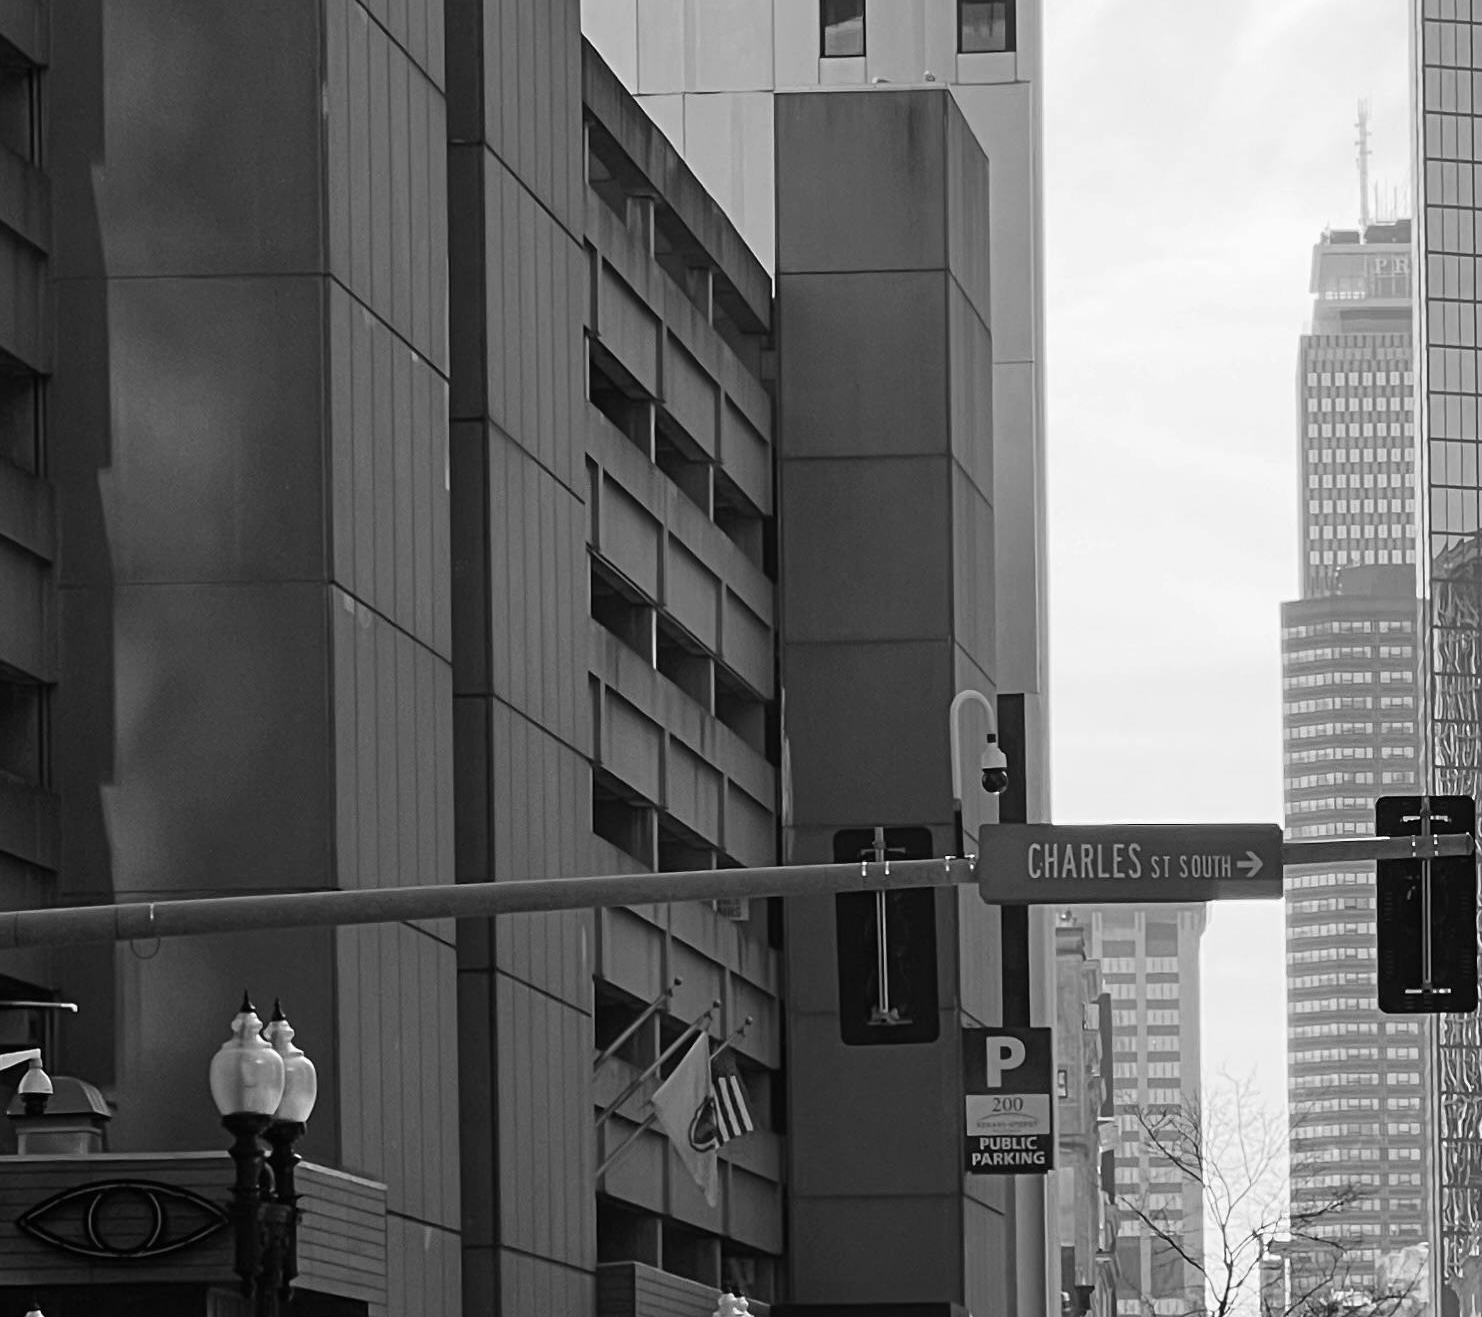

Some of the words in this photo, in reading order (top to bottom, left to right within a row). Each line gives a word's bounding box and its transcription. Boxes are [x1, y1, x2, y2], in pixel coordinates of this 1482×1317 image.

[1028, 842, 1142, 879] CHARLES
[1150, 855, 1170, 878] ST
[1179, 855, 1232, 878] SOUTH
[986, 1035, 1026, 1088] P
[992, 1097, 1024, 1112] 200
[979, 1136, 1038, 1151] PUBLIC
[971, 1151, 1046, 1166] PARKING
